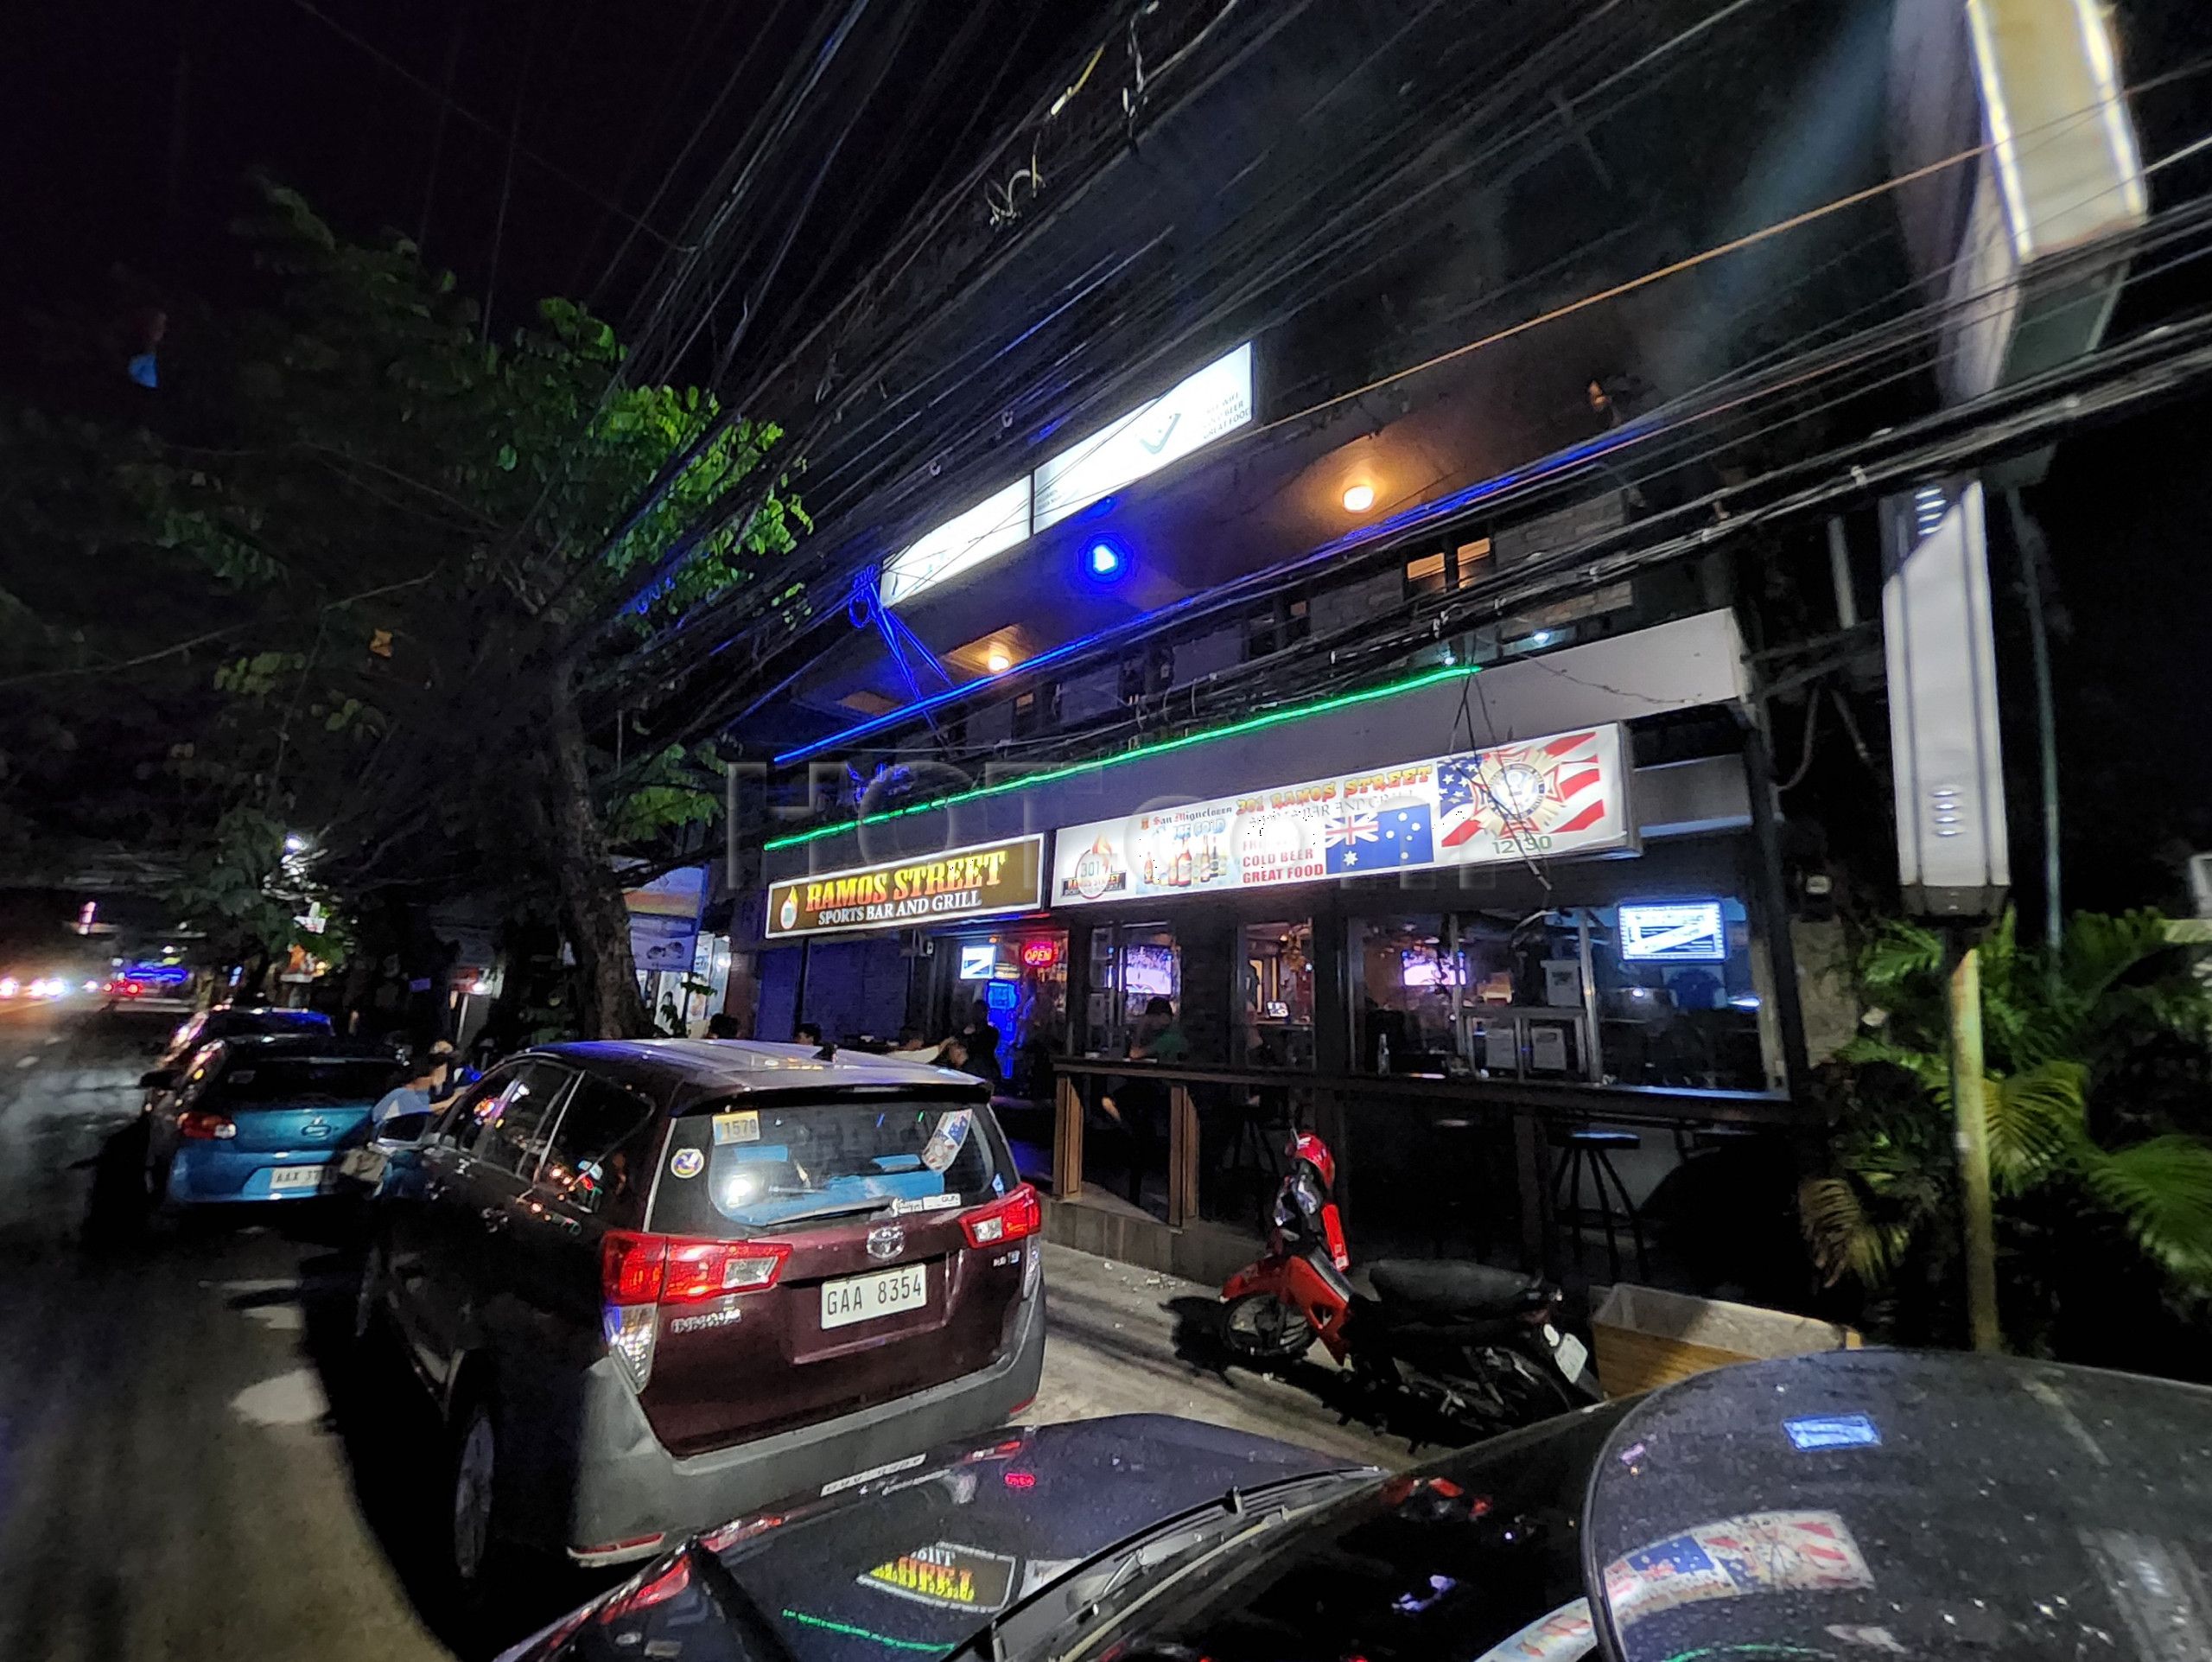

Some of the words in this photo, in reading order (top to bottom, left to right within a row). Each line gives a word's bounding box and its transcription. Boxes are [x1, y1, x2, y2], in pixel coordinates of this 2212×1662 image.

[1271, 781, 1337, 809] RAMOS
[1344, 764, 1433, 799] STREET
[1243, 853, 1276, 868] COLD
[1280, 847, 1313, 863] BEER
[1243, 868, 1283, 884] GREAT
[1287, 863, 1324, 879] FOOD
[805, 872, 889, 912] RAMOS
[893, 850, 1007, 901] STREET
[818, 906, 865, 926] SPORTS
[865, 902, 894, 921] BAR
[895, 898, 930, 917] AND
[931, 890, 982, 912] GRILL
[1024, 949, 1052, 962] OPEN
[827, 1283, 863, 1315] GAA
[877, 1274, 922, 1304] 8354
